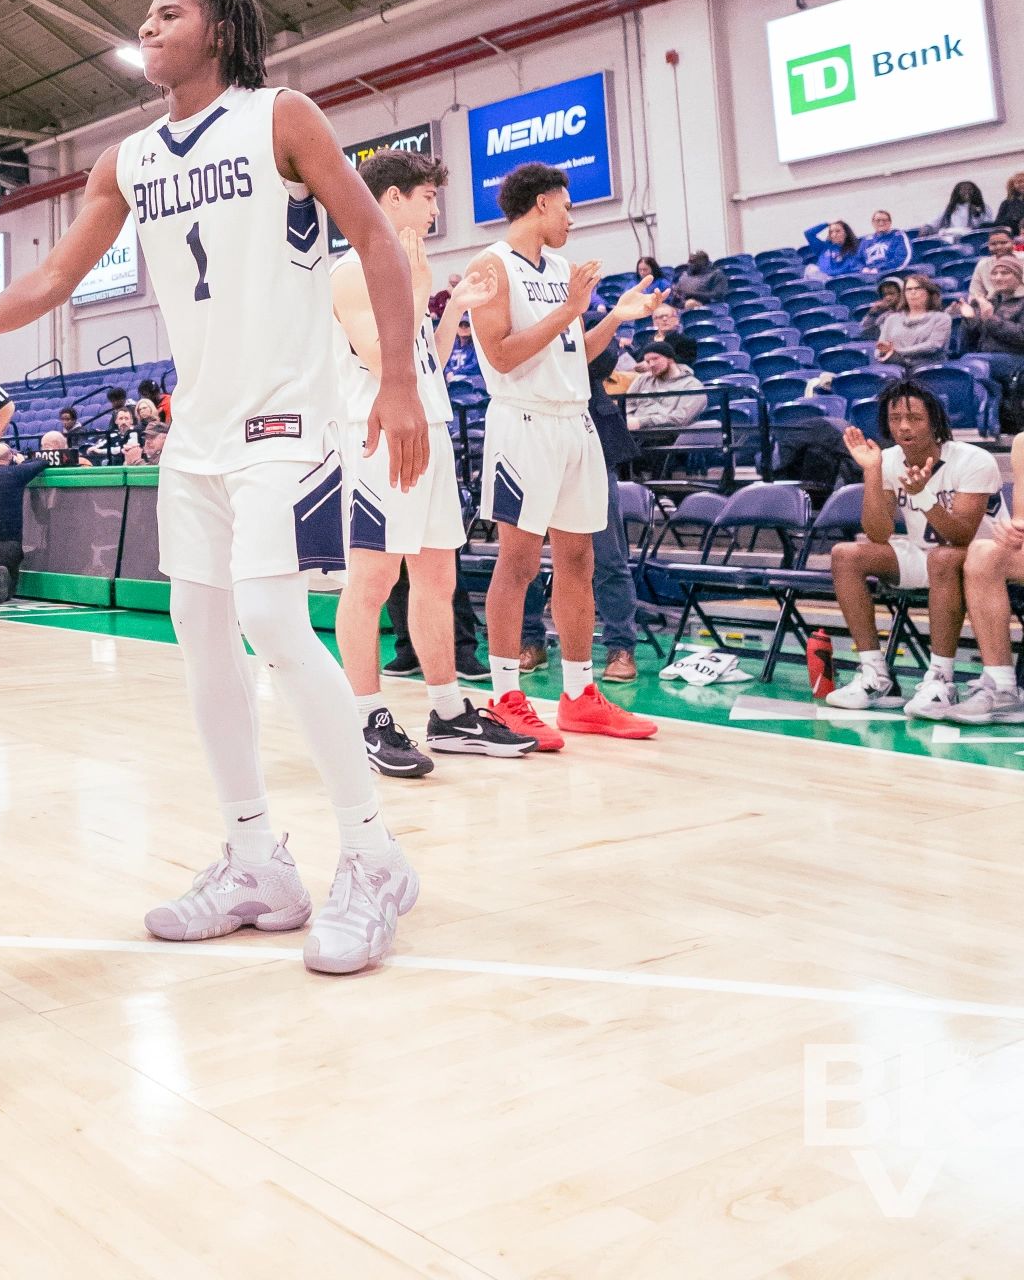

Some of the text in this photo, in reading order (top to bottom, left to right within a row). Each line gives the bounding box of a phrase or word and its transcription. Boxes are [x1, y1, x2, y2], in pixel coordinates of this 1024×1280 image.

[791, 34, 964, 103] TD Bank
[486, 104, 587, 157] MEMIC
[133, 156, 253, 225] BULLDOGS
[185, 221, 211, 302] 1
